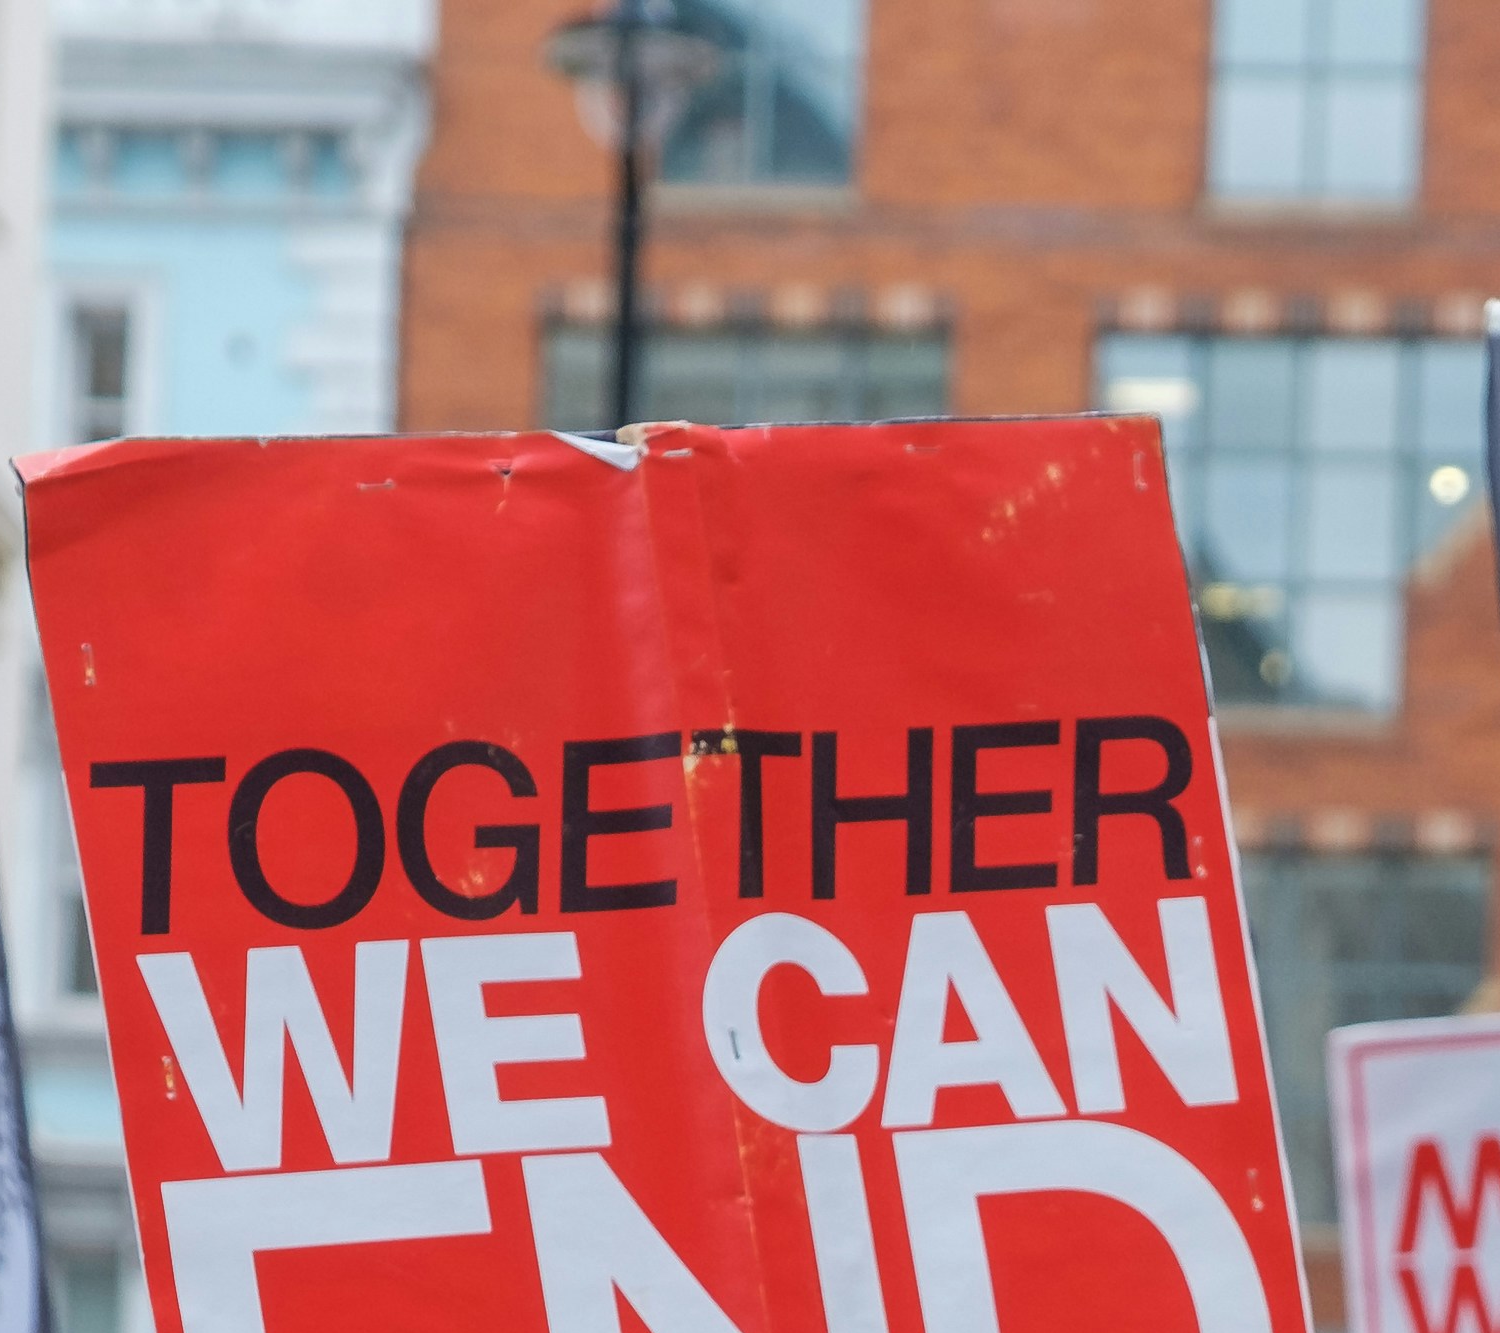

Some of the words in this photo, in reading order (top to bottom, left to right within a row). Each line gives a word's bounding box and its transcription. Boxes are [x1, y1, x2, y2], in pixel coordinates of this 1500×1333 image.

[88, 714, 1195, 936] TOGETHER
[135, 930, 612, 1173] WE
[700, 894, 1240, 1136] CAN
